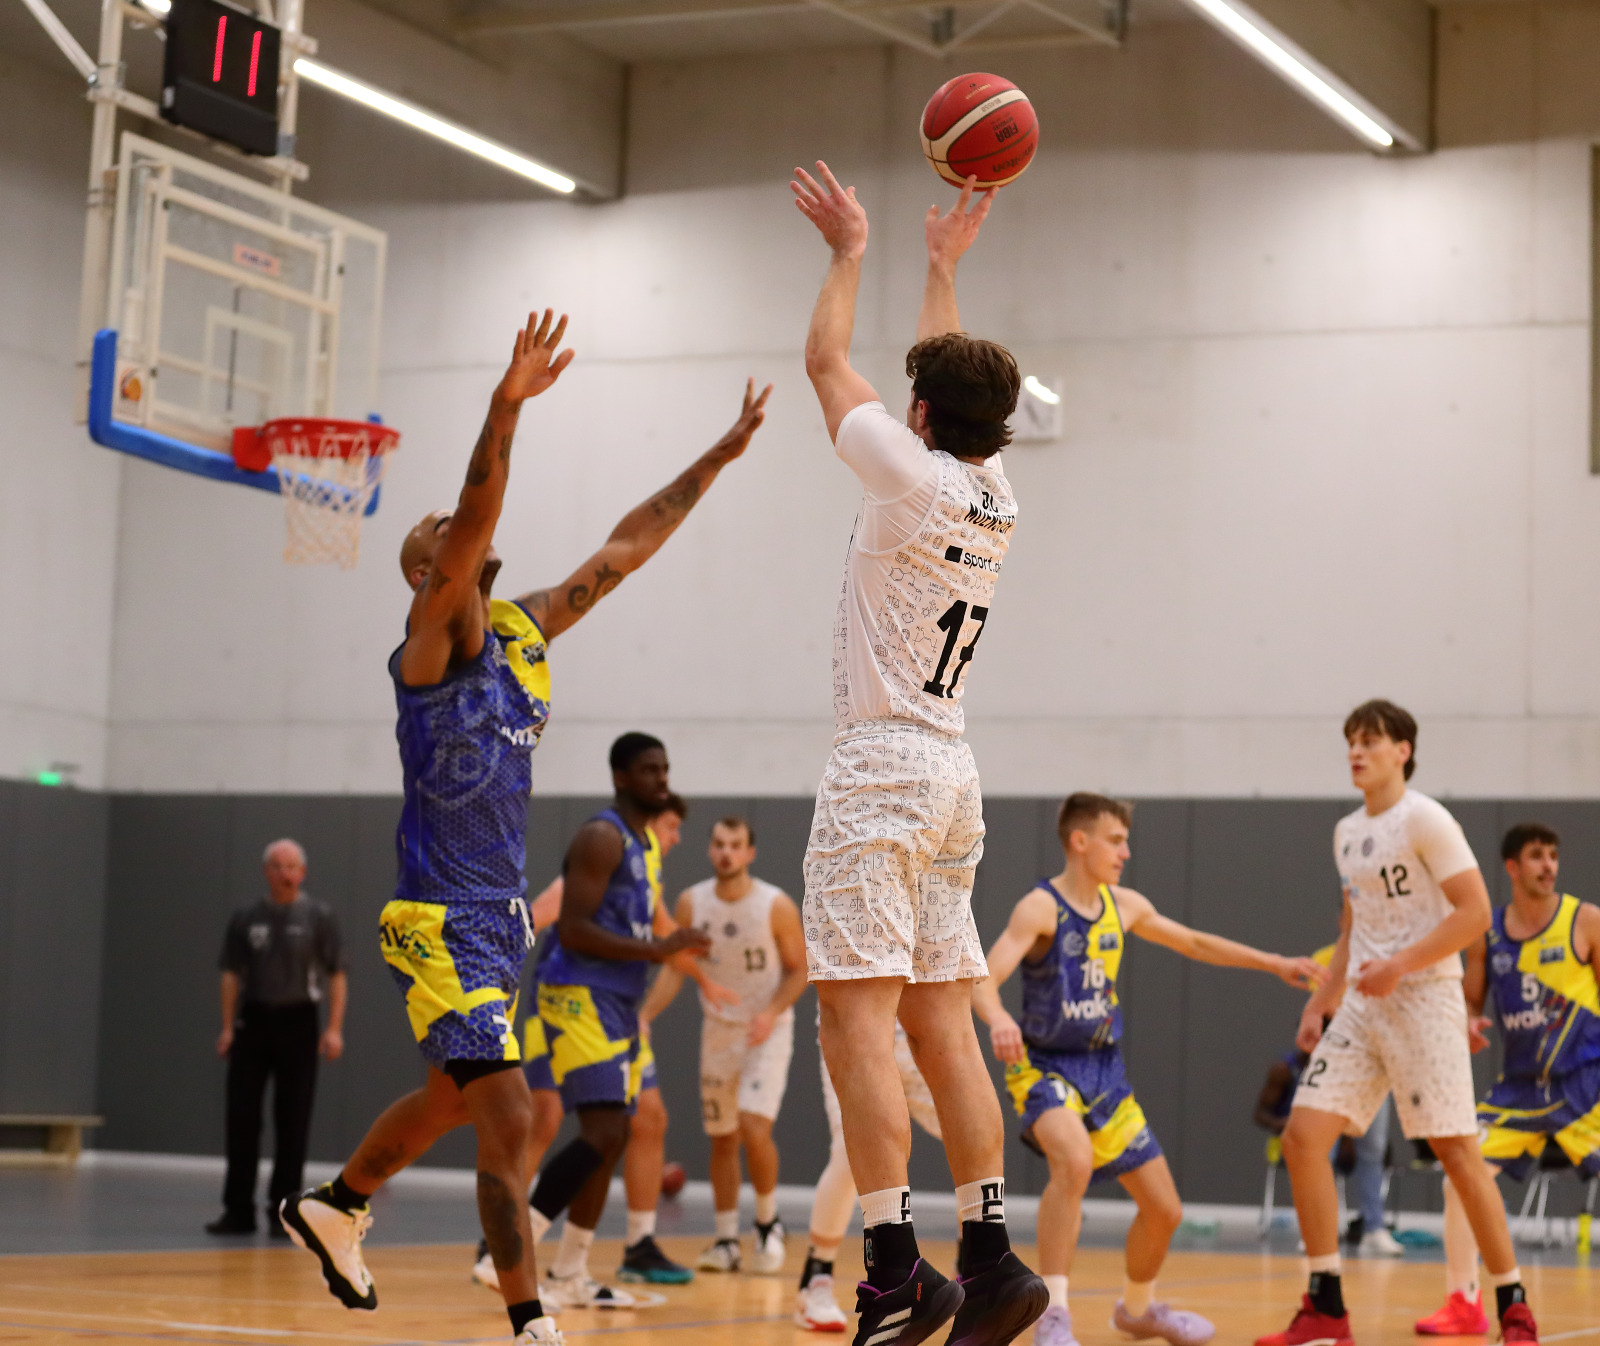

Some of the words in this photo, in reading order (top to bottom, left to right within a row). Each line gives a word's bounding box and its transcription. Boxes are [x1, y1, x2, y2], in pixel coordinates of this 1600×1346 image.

[212, 15, 262, 97] 11
[994, 121, 1020, 143] FIBA
[922, 599, 989, 699] 17
[1380, 864, 1411, 898] 12
[744, 947, 766, 972] 13
[1080, 957, 1106, 990] 16
[1521, 972, 1540, 1002] 5
